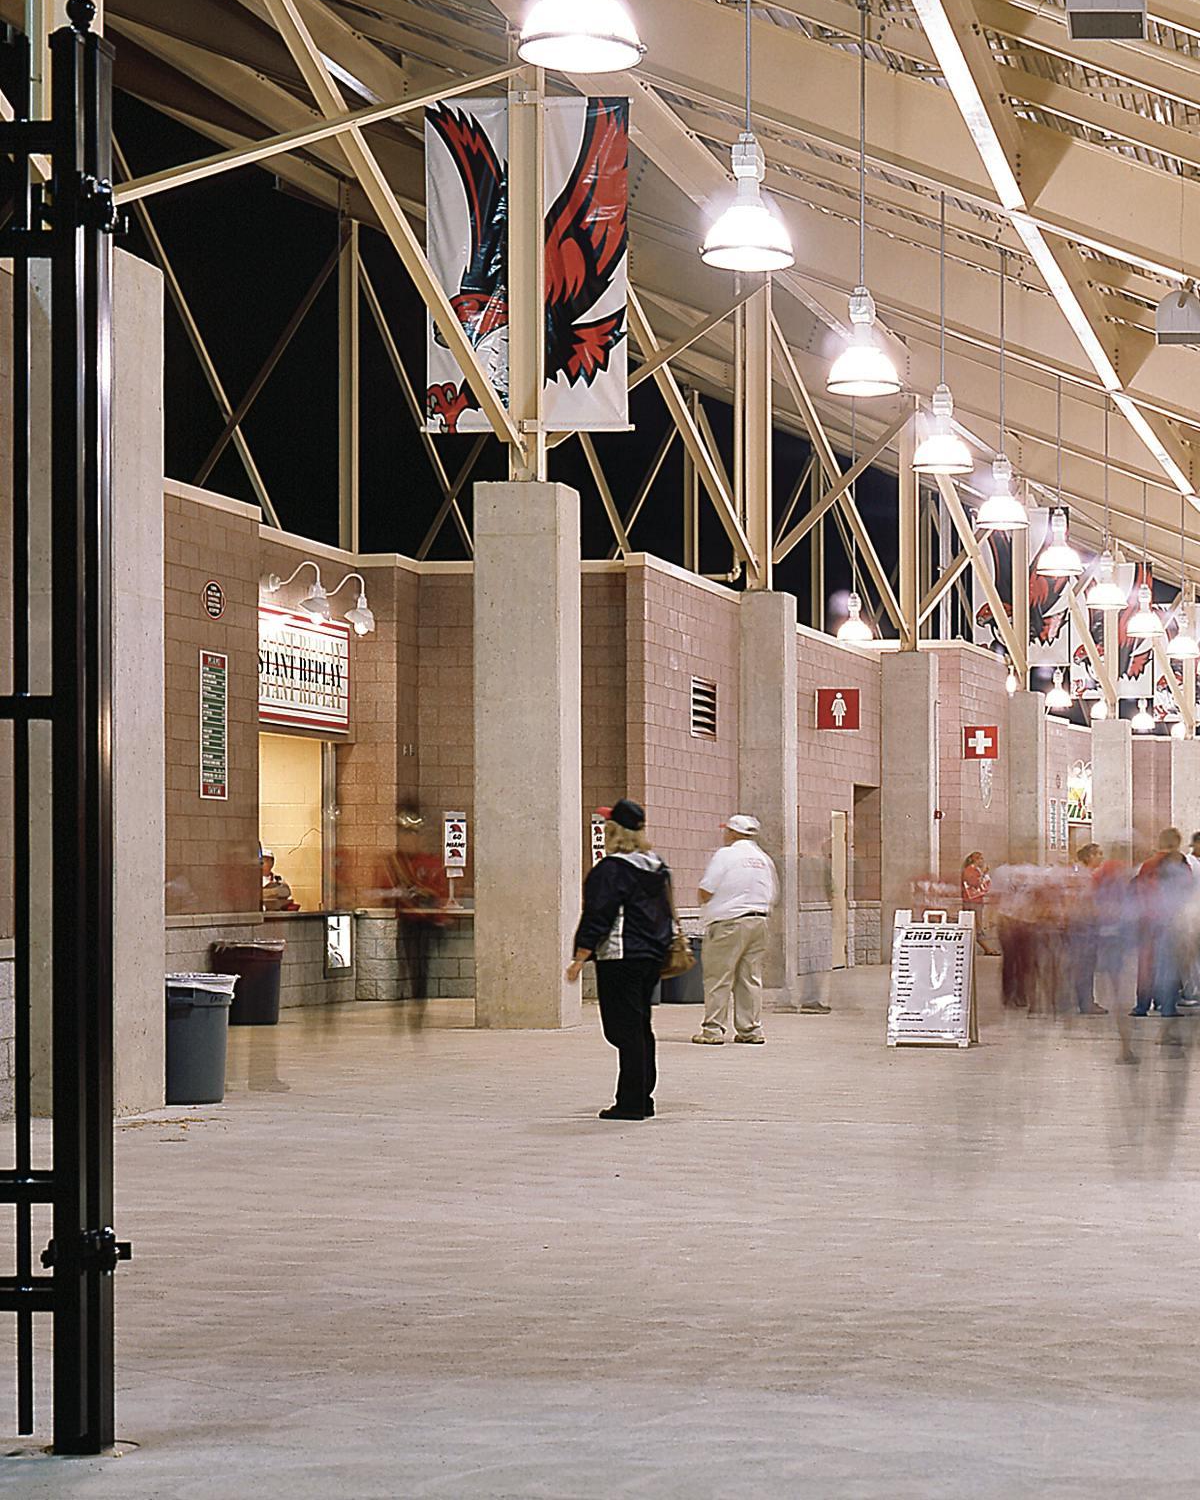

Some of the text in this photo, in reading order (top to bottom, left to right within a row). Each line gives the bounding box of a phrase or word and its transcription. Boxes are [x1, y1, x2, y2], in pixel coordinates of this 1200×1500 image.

[299, 657, 343, 689] REPLAY
[904, 931, 964, 941] END RUN
